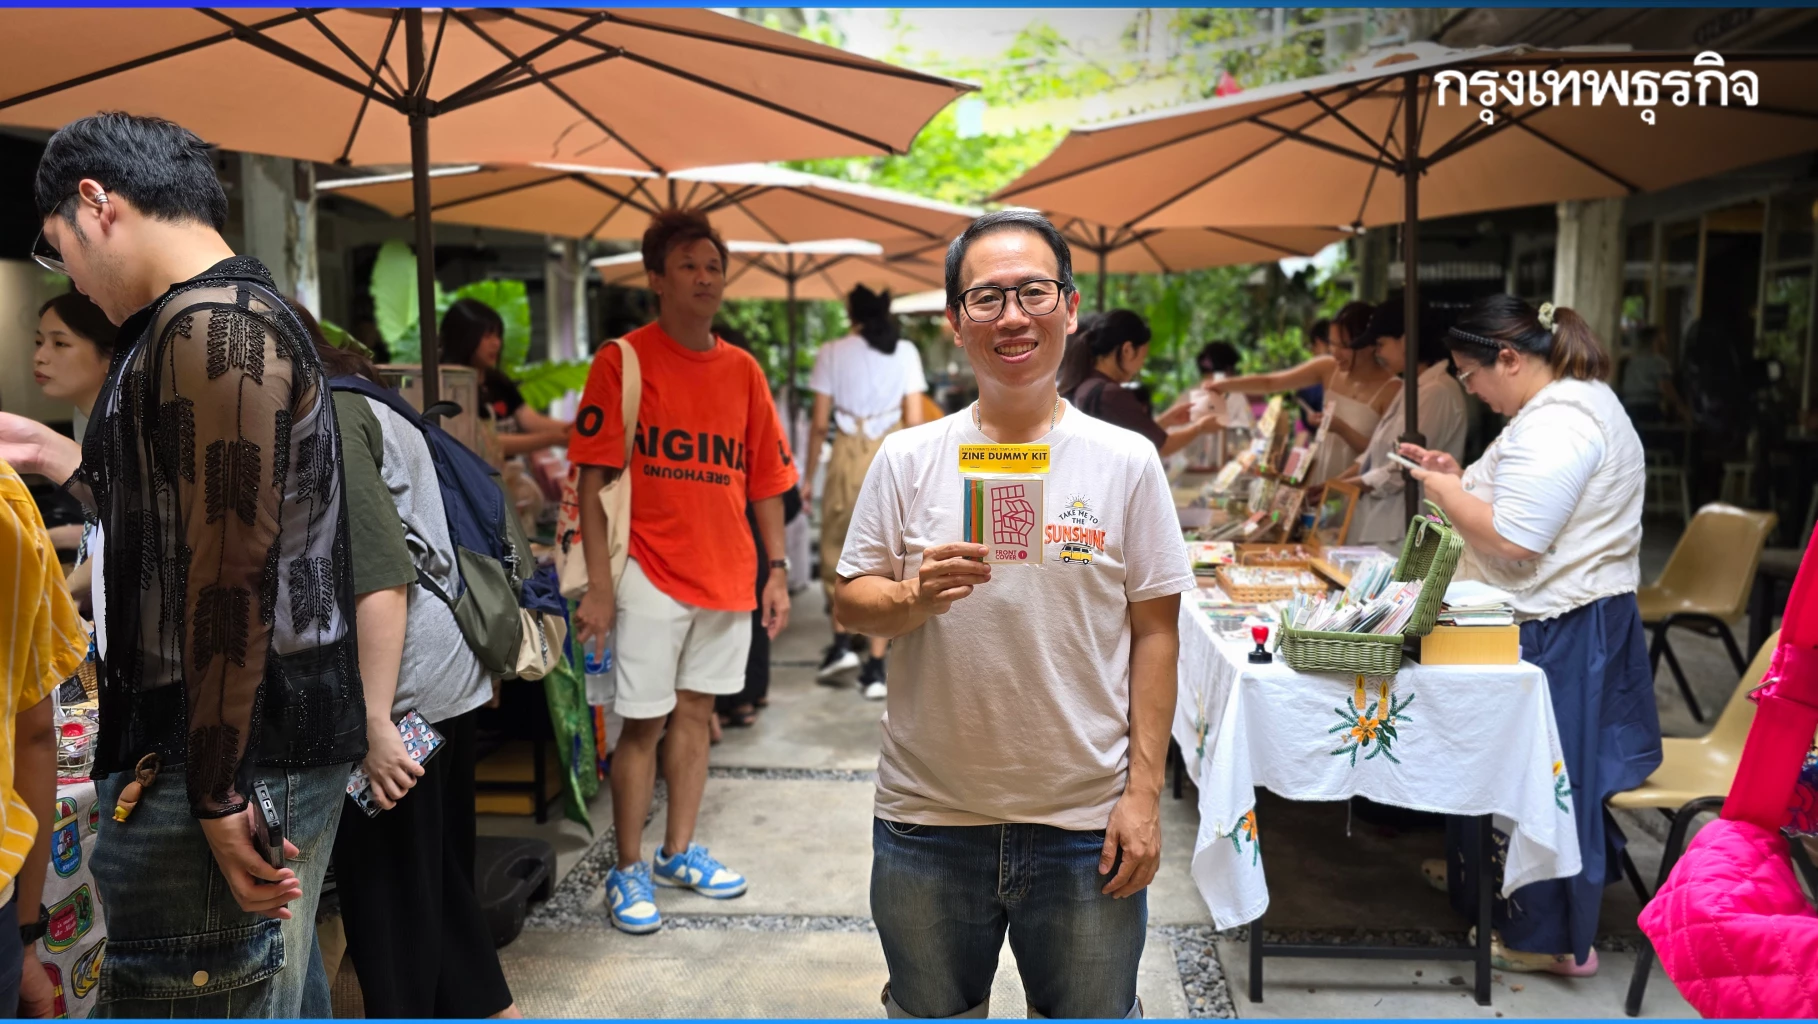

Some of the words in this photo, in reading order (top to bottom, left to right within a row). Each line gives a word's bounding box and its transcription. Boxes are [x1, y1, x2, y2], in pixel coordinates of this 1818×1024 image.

[576, 404, 604, 437] O
[961, 452, 985, 460] ZINE
[988, 452, 1028, 460] DUMMY
[1031, 452, 1048, 460] KIT
[642, 464, 730, 486] GREYHOUND
[1059, 509, 1077, 520] TAKE
[1078, 509, 1088, 519] ME
[1089, 515, 1099, 524] TO
[1072, 517, 1085, 525] THE
[1044, 524, 1106, 552] SUNSHINE
